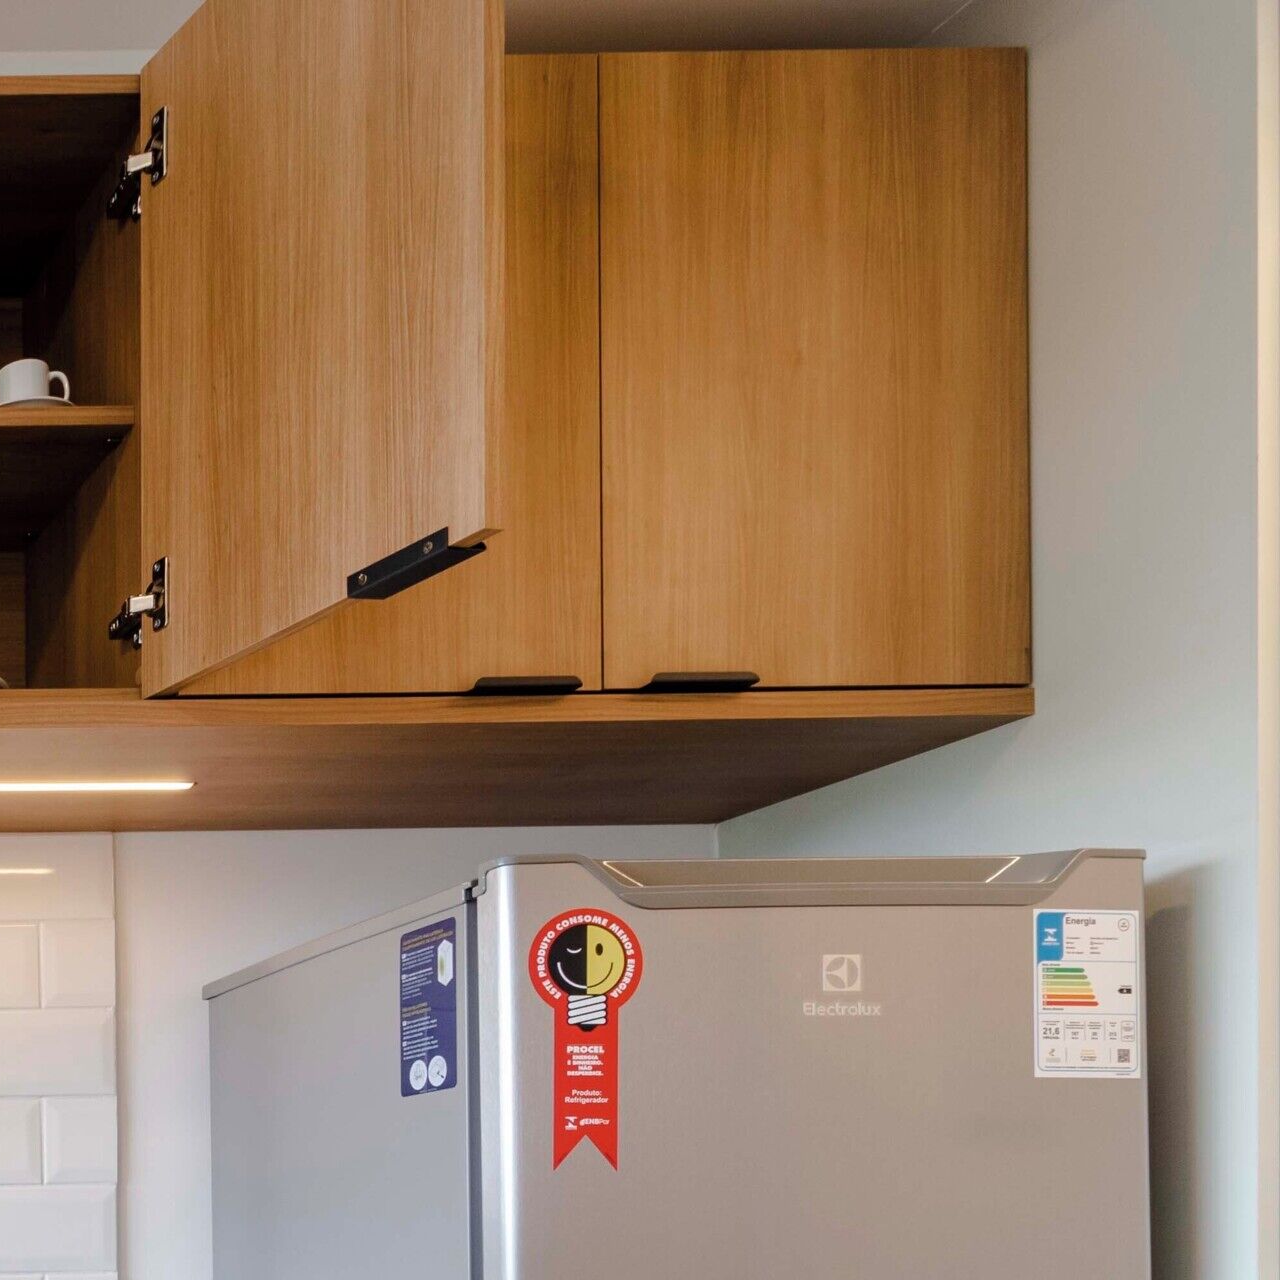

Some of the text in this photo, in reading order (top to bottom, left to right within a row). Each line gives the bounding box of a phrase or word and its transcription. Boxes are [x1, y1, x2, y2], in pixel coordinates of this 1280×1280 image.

[1065, 916, 1097, 927] Energia
[537, 915, 636, 999] ESTE PRODUTO CONSOME MENOS ENERGIA
[803, 1001, 882, 1016] Electrolux
[566, 1045, 605, 1054] PROCEL
[564, 1096, 609, 1105] Refrigerador
